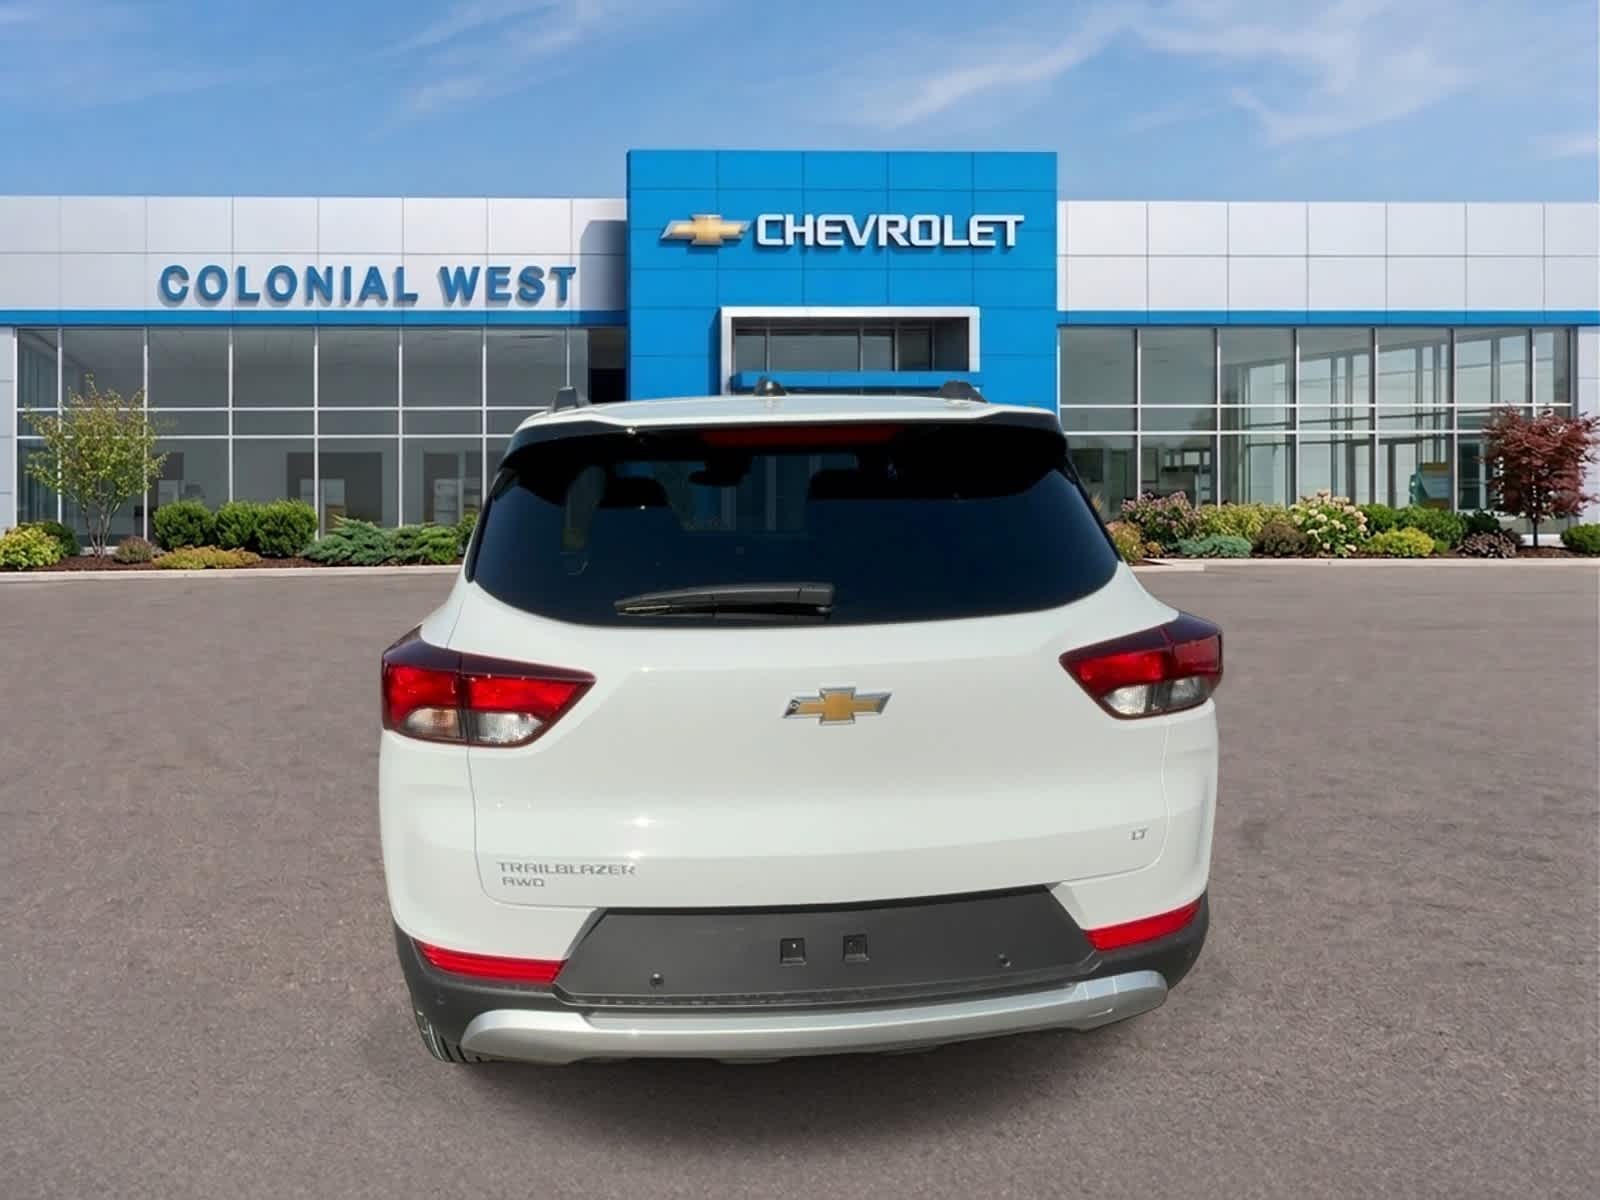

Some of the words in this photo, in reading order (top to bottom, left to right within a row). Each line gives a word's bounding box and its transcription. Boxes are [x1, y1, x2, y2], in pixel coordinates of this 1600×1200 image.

[756, 213, 1024, 247] CHEVROLET
[159, 264, 419, 305] COLONIAL
[439, 265, 577, 304] WEST
[1131, 828, 1149, 841] LT
[497, 861, 637, 876] TRAILBLAZER
[501, 876, 546, 888] AWD
